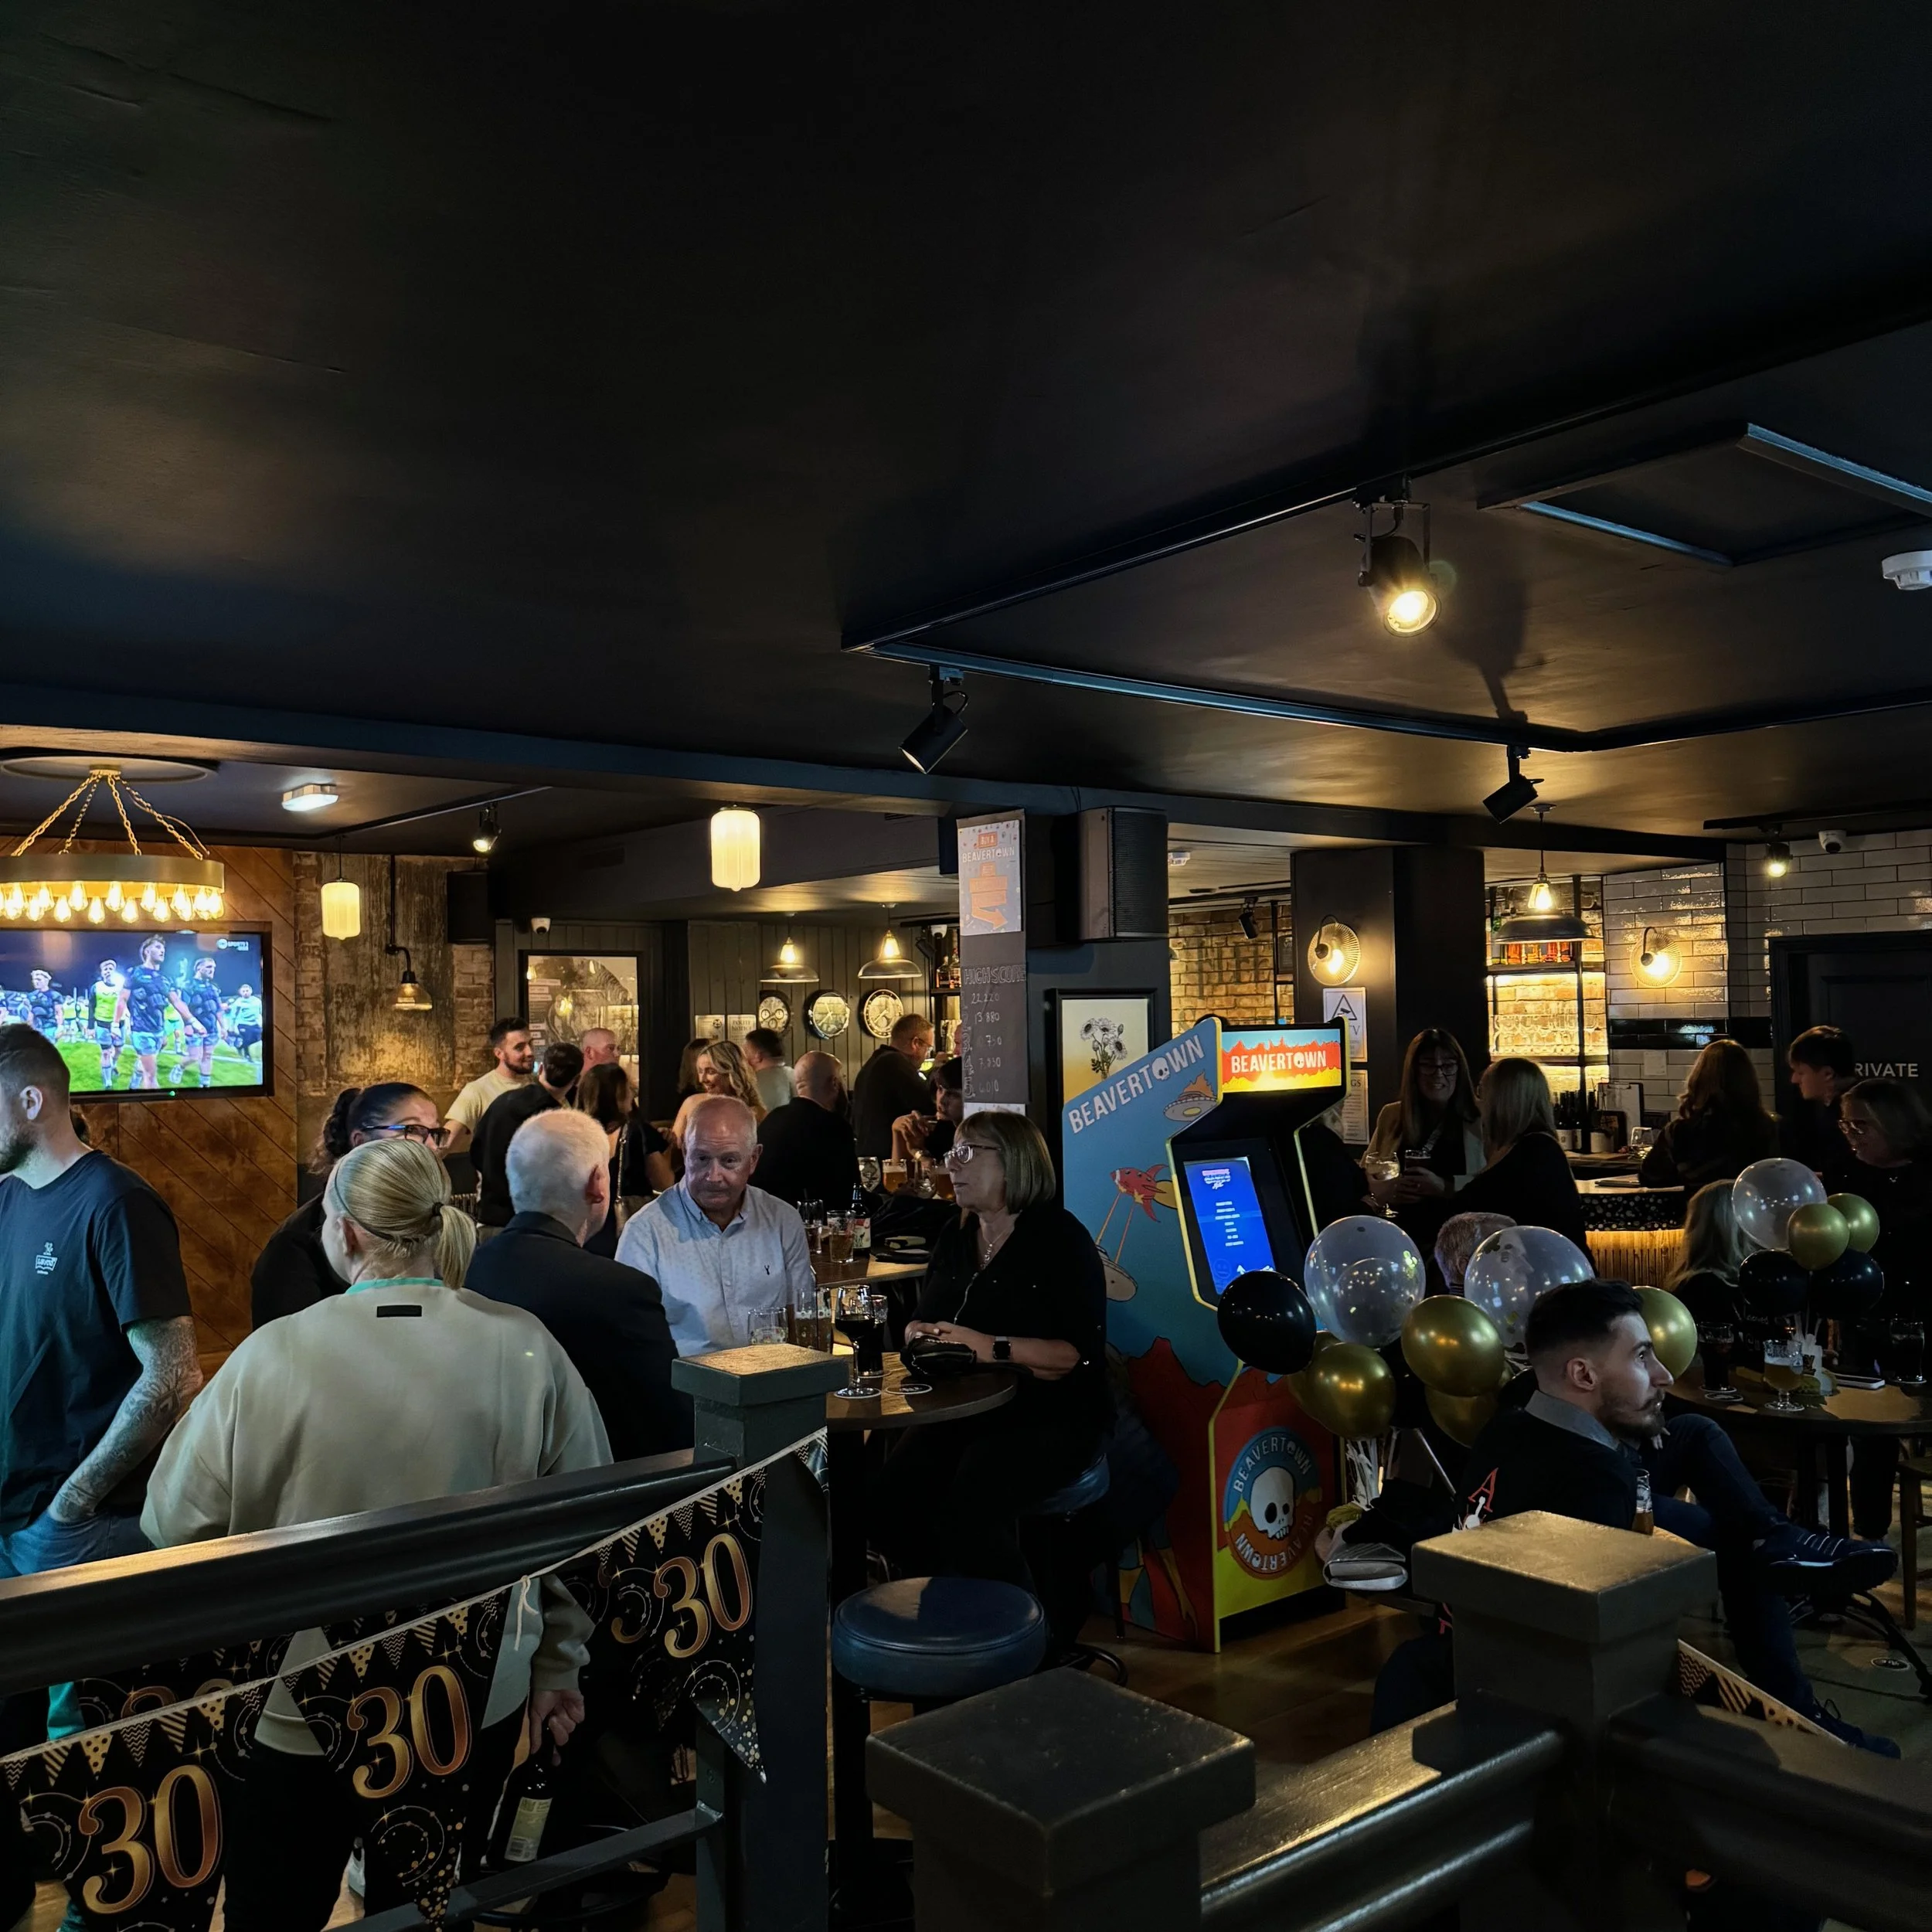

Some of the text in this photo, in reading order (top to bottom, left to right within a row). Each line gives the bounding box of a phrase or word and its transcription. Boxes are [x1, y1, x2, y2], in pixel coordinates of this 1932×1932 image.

[962, 846, 1015, 863] BEAVERTOWN
[1068, 1035, 1206, 1135] BEAVERTOWN
[1231, 1050, 1327, 1073] BEAVERTOWN
[1855, 1063, 1919, 1077] RIVATE
[1233, 1437, 1312, 1493] BEAVERTOWN
[653, 1532, 753, 1658] 30
[347, 1665, 472, 1799] 30
[78, 1764, 223, 1915] 30
